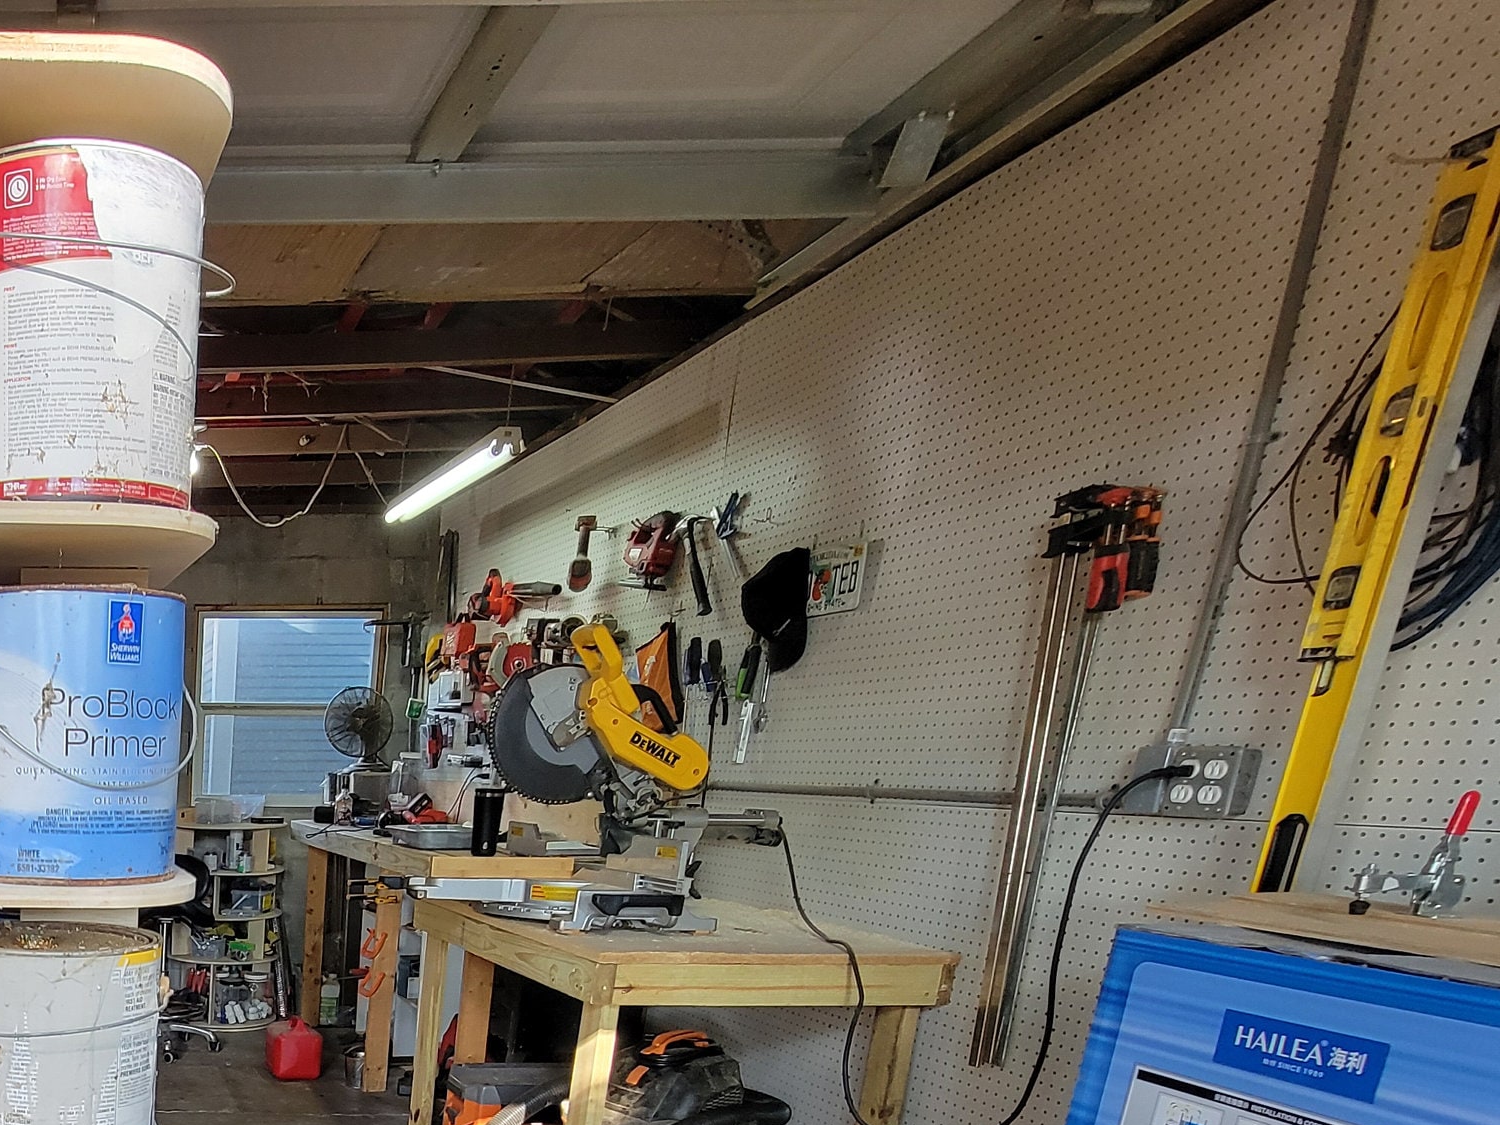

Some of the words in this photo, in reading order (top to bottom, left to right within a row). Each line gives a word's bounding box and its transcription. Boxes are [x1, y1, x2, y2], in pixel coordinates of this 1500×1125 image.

[111, 642, 140, 653] SHERWIN
[110, 652, 140, 662] WILLIAMS
[42, 687, 178, 720] ProBlock
[65, 728, 167, 758] Primer
[91, 767, 117, 776] STAIN
[94, 796, 112, 805] OIL
[119, 796, 148, 805] BASED
[17, 849, 40, 857] WHITE
[1234, 1026, 1322, 1066] HAILEA
